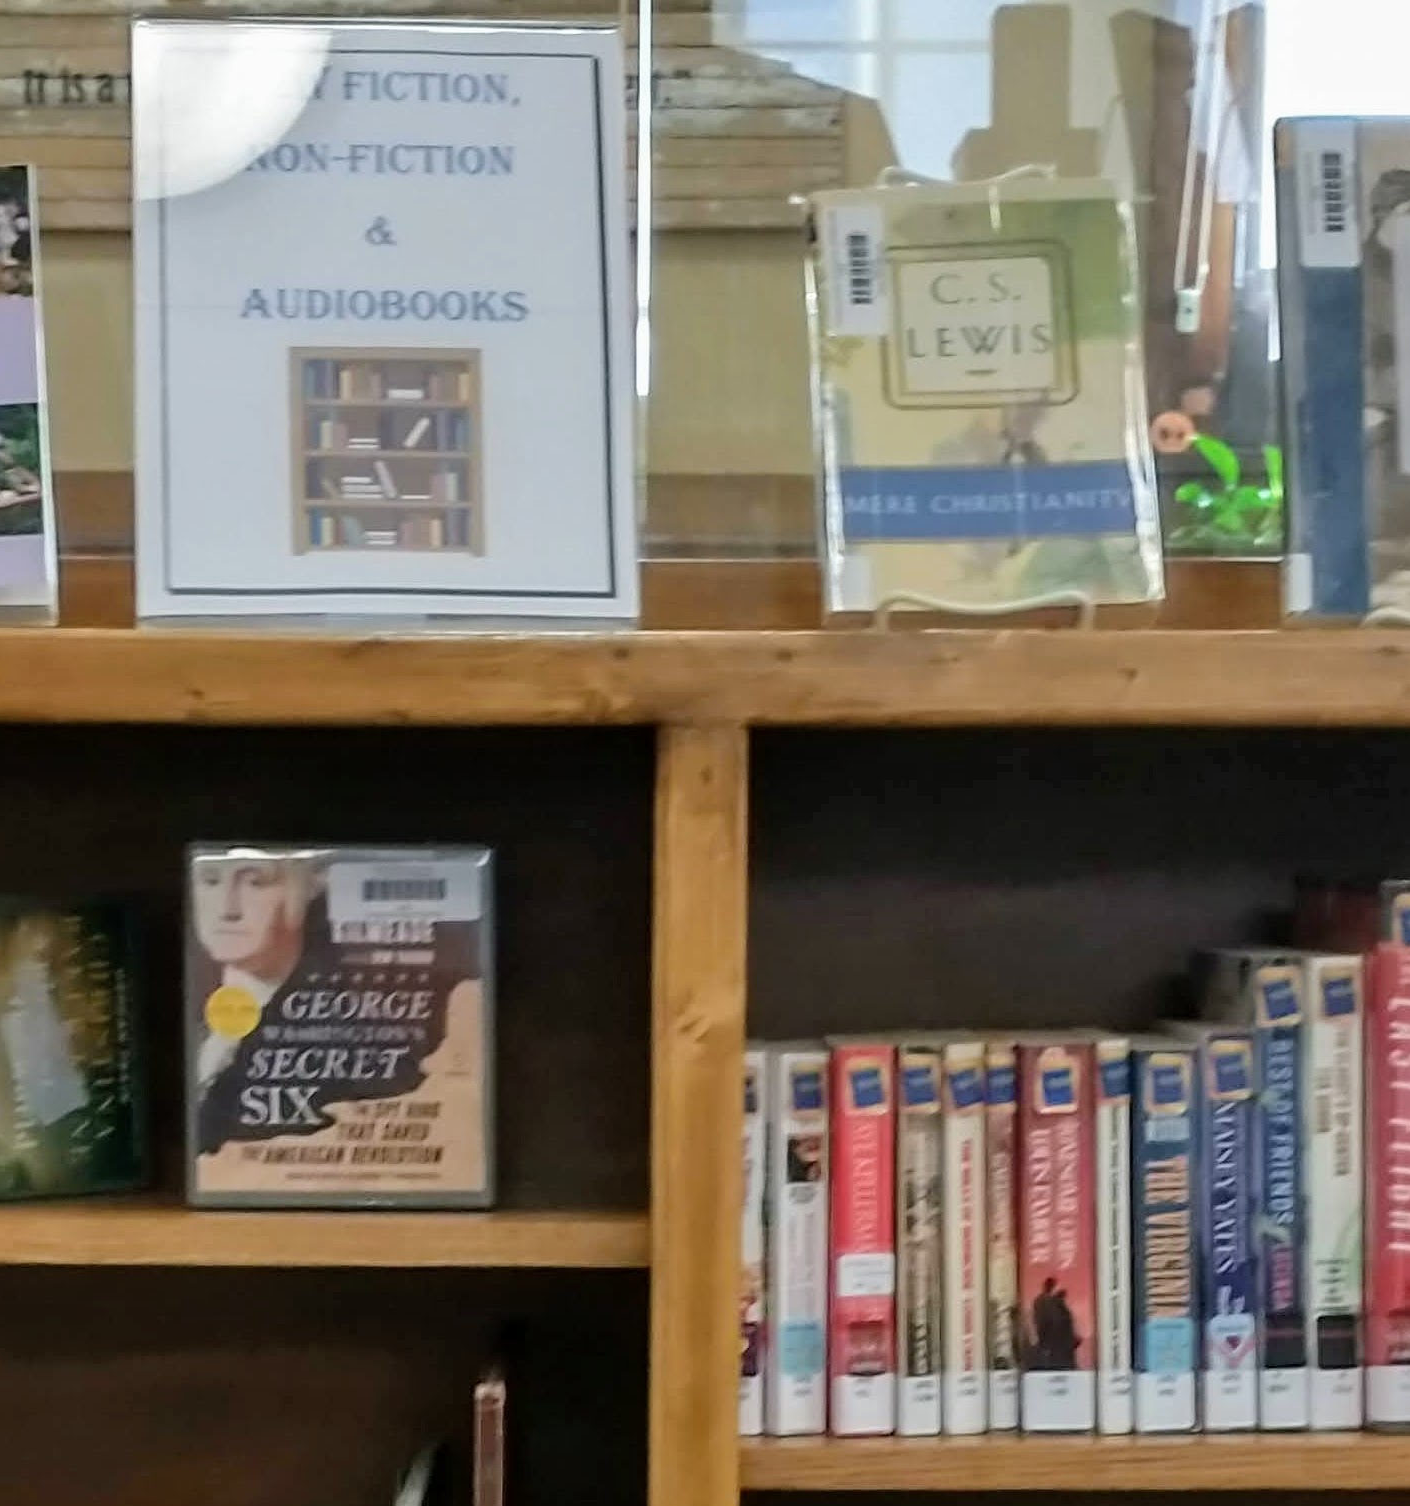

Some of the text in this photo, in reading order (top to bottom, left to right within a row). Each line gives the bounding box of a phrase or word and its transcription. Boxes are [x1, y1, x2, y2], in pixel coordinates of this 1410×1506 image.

[342, 70, 521, 106] FICTION,
[364, 216, 397, 246] &
[240, 287, 529, 322] AUDIOBOOKS
[930, 272, 1022, 304] C. S.
[906, 322, 1052, 359] LEWIS
[843, 487, 1133, 516] MERE CHRISTIANITY
[281, 990, 436, 1021] GEORGE
[247, 1048, 411, 1081] SECRET
[1268, 1038, 1296, 1091] BEST
[239, 1085, 325, 1127] SIX
[1268, 1098, 1296, 1125] OF
[1268, 1132, 1296, 1225] FRIENDS
[1145, 1154, 1189, 1319] THE VIRGINIA
[1213, 1198, 1239, 1274] YATES
